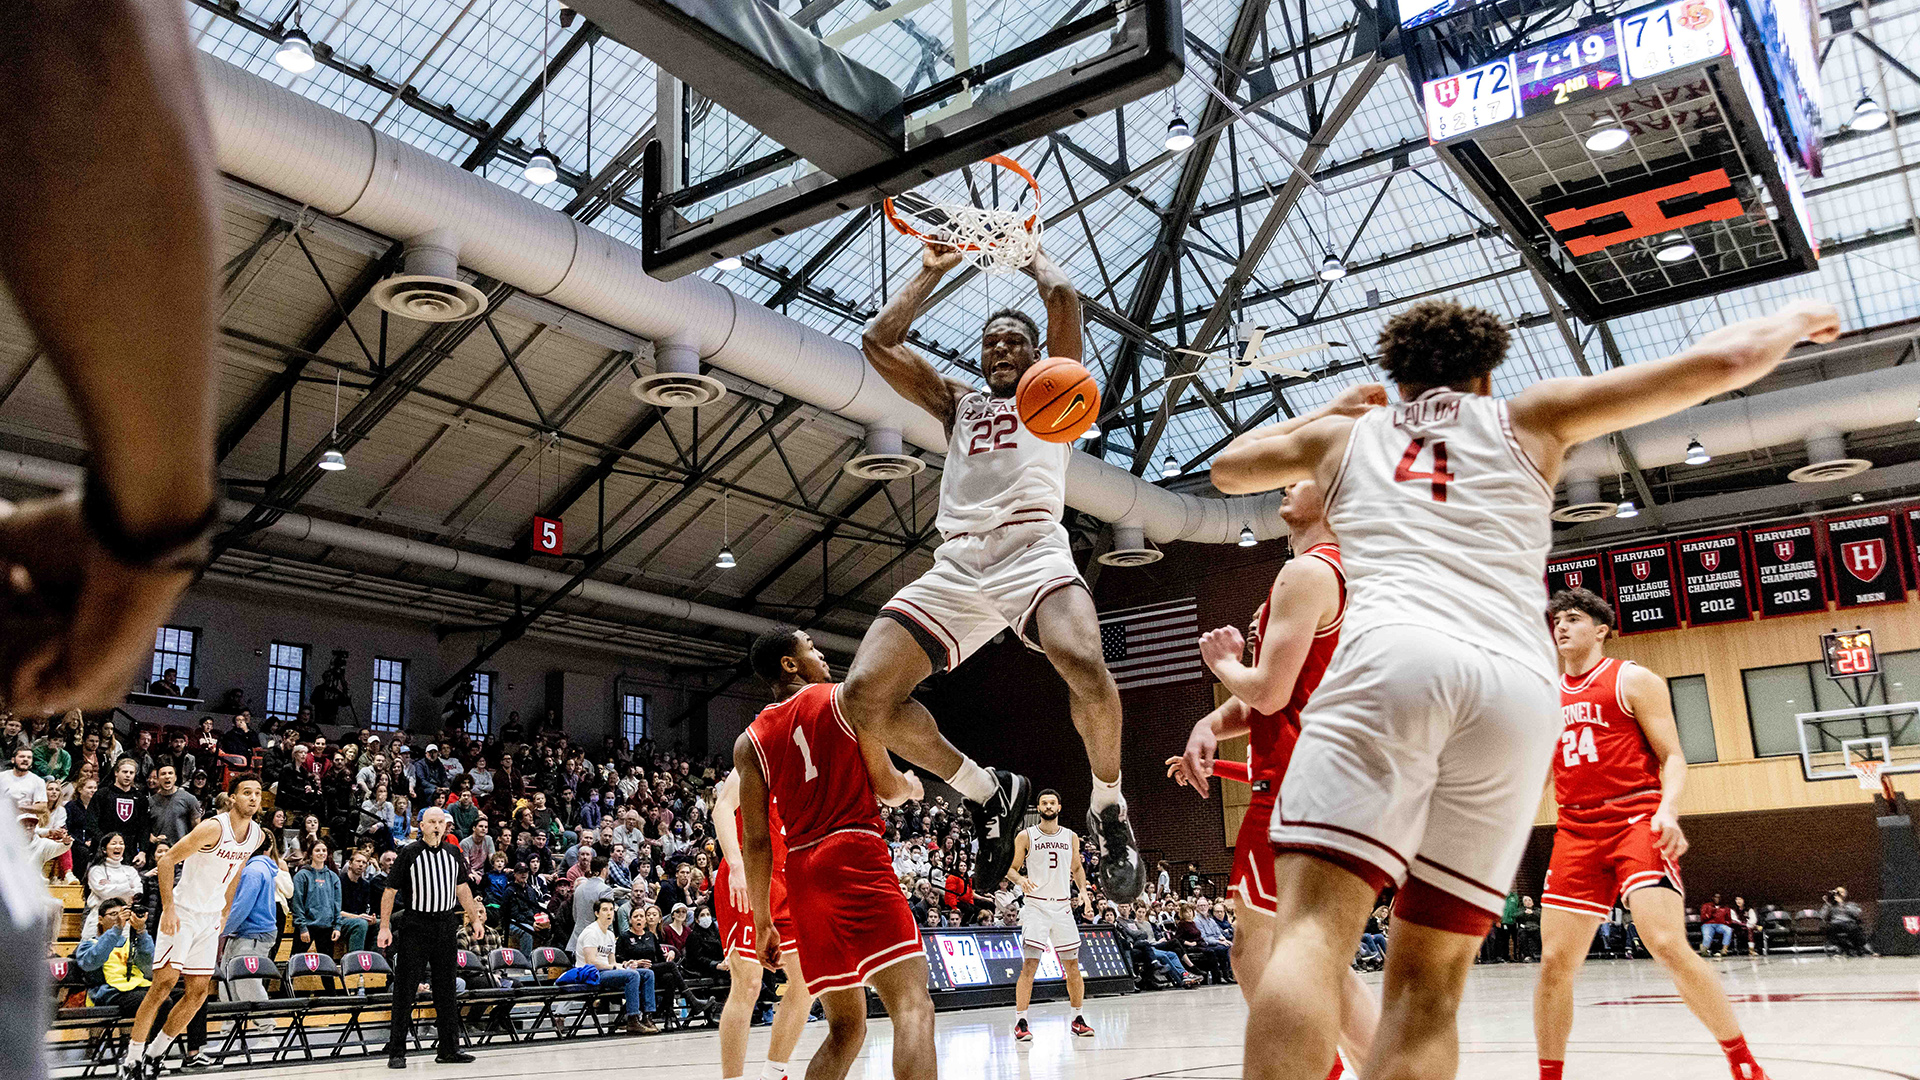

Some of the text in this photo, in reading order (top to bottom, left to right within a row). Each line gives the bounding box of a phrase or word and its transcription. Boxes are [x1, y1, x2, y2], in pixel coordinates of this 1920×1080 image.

[1627, 9, 1673, 48] 71
[1527, 34, 1606, 80] 7:19
[1466, 64, 1510, 101] 72
[1552, 75, 1589, 105] 2ND
[968, 413, 1018, 457] 22
[1394, 437, 1454, 502] 4
[1829, 515, 1889, 532] HARVARD
[542, 521, 557, 549] 5
[1754, 527, 1811, 542] HARVARD
[1682, 538, 1736, 552] HARVARD
[1778, 543, 1790, 556] H
[1614, 548, 1666, 563] HARVARD
[1705, 553, 1716, 566] H
[1852, 544, 1877, 570] H
[1548, 559, 1597, 573] HARVARD
[1636, 563, 1647, 576] H
[1760, 560, 1816, 576] IVY LEAGUE
[1569, 573, 1580, 586] H
[1687, 570, 1740, 585] IVY LEAGUE
[1761, 569, 1818, 584] CHAMPIONS
[1619, 580, 1669, 595] IVY LEAGUE
[1687, 579, 1742, 594] CHAMPIONS
[1620, 589, 1671, 603] CHAMPIONS
[1773, 588, 1811, 604] 2013
[1856, 592, 1886, 603] MEN
[1700, 597, 1735, 613] 2012
[1632, 607, 1664, 622] 2011
[1837, 648, 1871, 673] 20
[1561, 701, 1610, 728] RNELL
[792, 725, 818, 783] 1
[1562, 726, 1599, 768] 24
[1034, 841, 1069, 851] HARVARD
[1048, 851, 1058, 869] 3
[743, 925, 753, 945] C
[958, 940, 974, 956] 72
[984, 940, 1014, 959] 7:19
